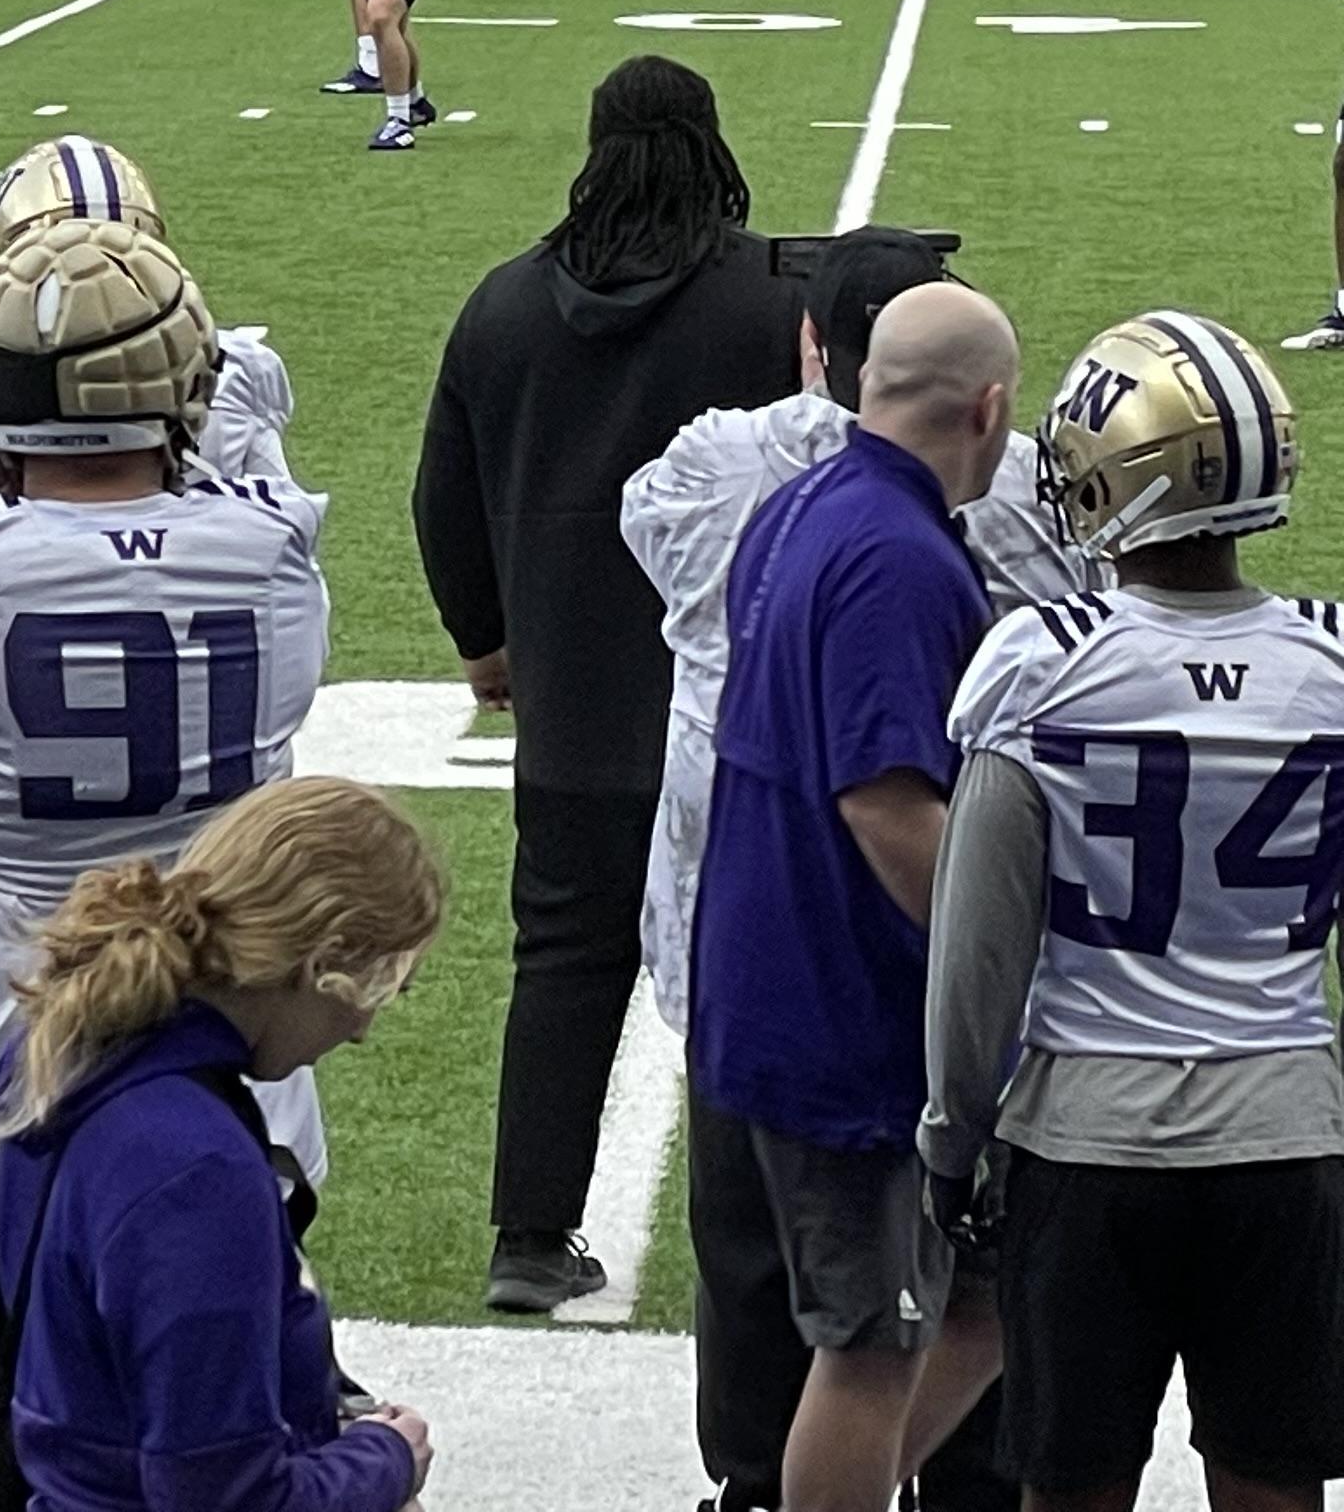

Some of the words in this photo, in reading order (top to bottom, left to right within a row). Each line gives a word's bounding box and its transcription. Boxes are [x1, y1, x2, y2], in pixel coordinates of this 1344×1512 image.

[1052, 358, 1136, 434] W
[100, 528, 169, 561] W
[3, 608, 261, 821] 91
[1182, 662, 1250, 702] W
[1030, 722, 1344, 957] 34
